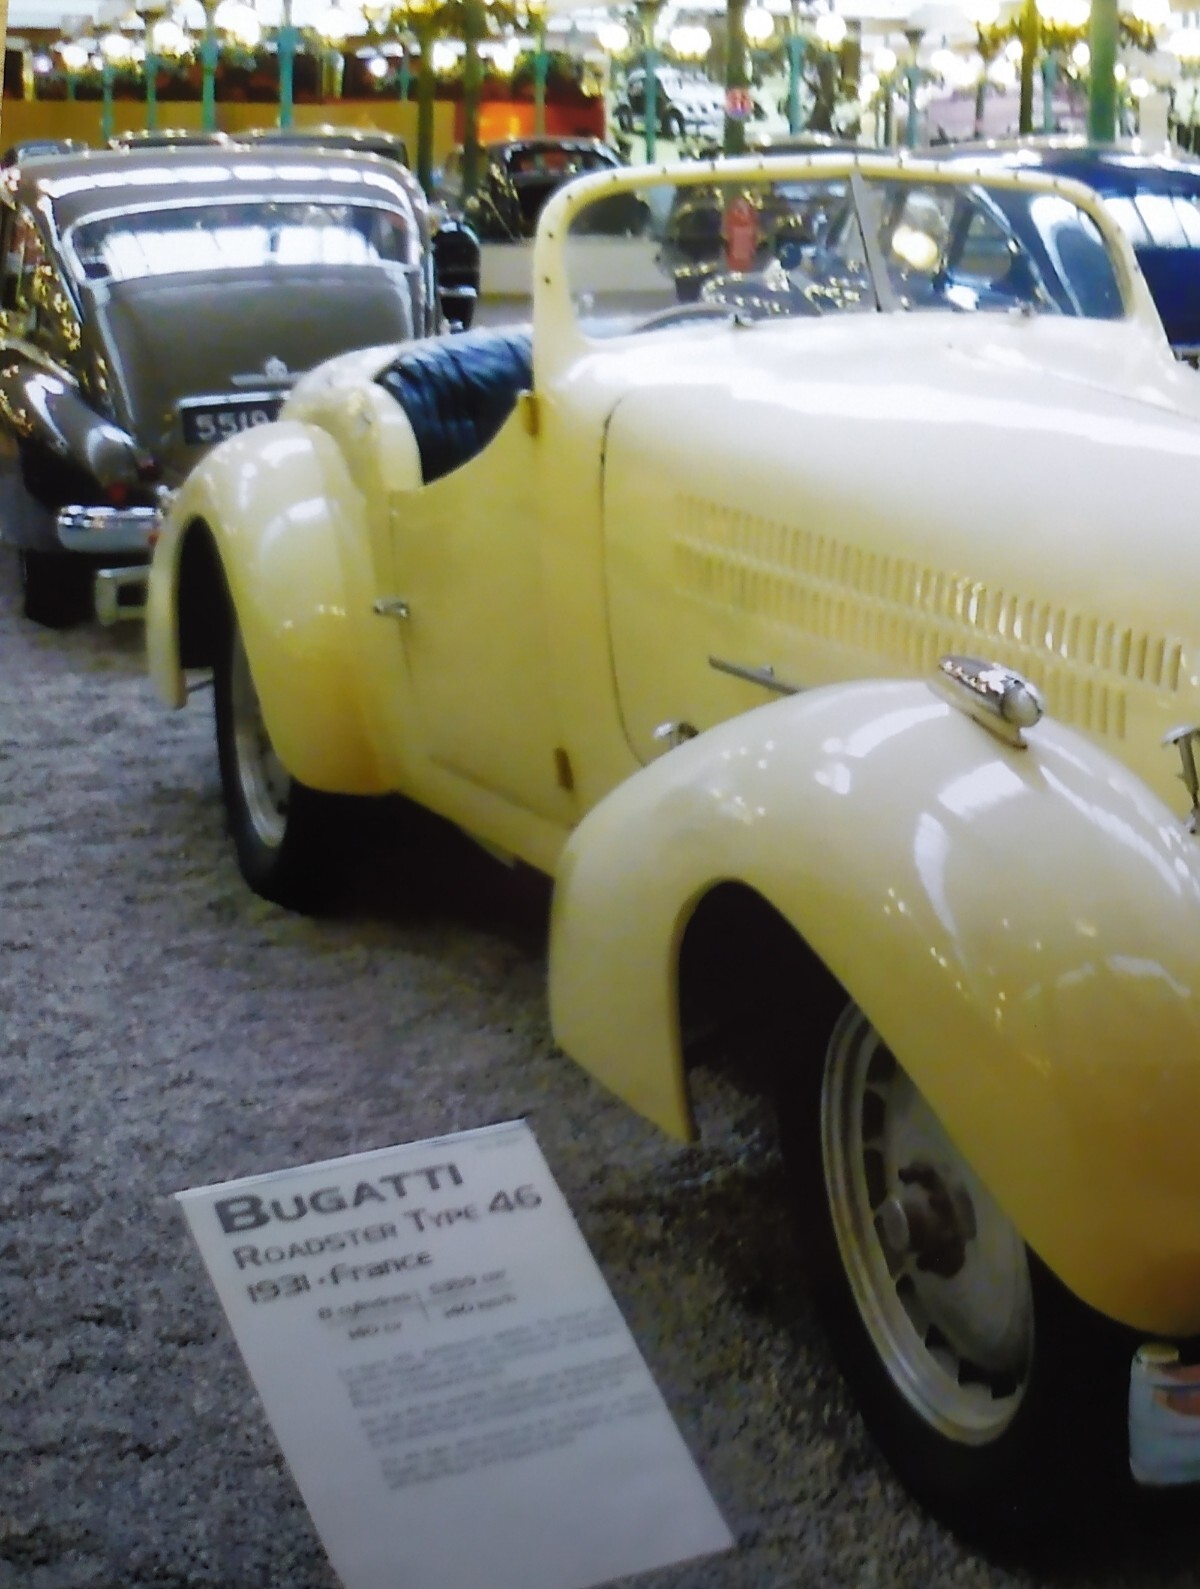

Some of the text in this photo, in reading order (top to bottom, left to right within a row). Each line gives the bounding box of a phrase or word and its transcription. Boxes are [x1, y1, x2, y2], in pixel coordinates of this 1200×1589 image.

[214, 1162, 463, 1234] BUGATTI
[233, 1183, 542, 1270] ROADSTER TYPE 46
[247, 1274, 311, 1304] 1931
[331, 1251, 432, 1286] France
